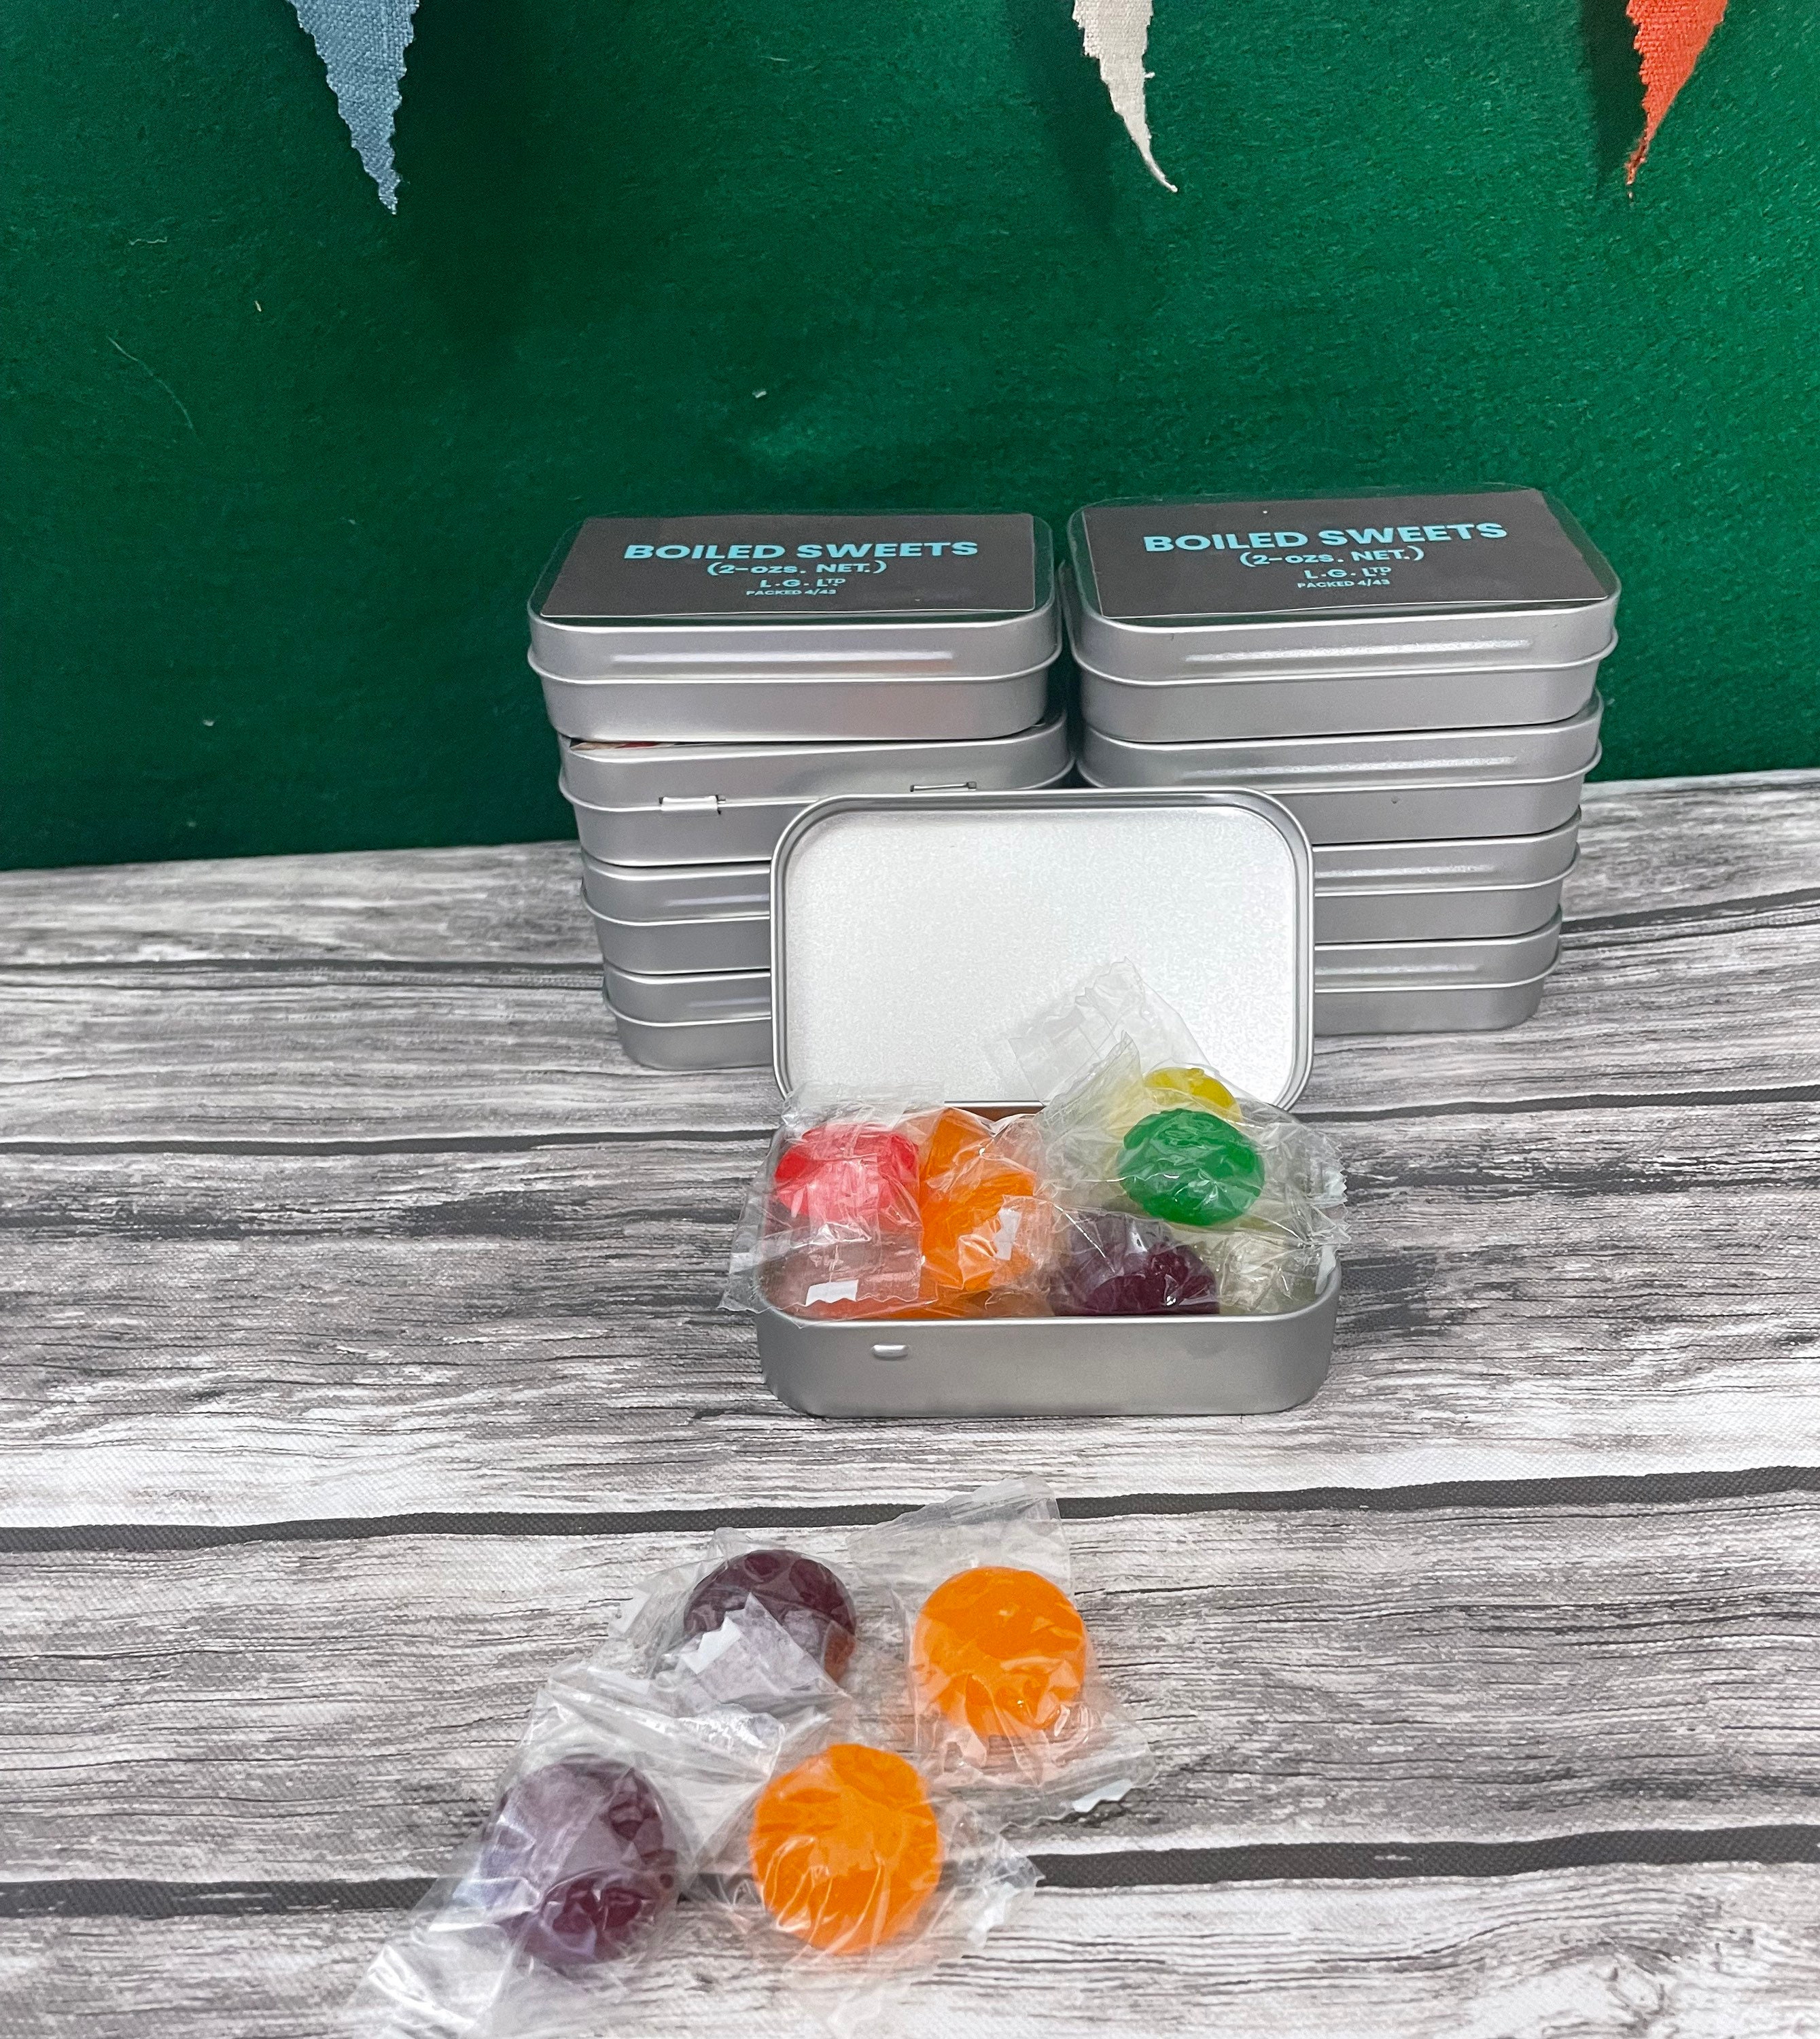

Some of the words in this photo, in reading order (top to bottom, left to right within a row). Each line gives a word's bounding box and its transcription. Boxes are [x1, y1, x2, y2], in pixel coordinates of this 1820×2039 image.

[1142, 531, 1309, 552] BOILED
[1318, 522, 1508, 546] SWEETS
[624, 544, 786, 560] BOILED
[795, 541, 979, 559] SWEETS
[1297, 580, 1355, 589] PACKED
[1357, 578, 1391, 587] 4/43
